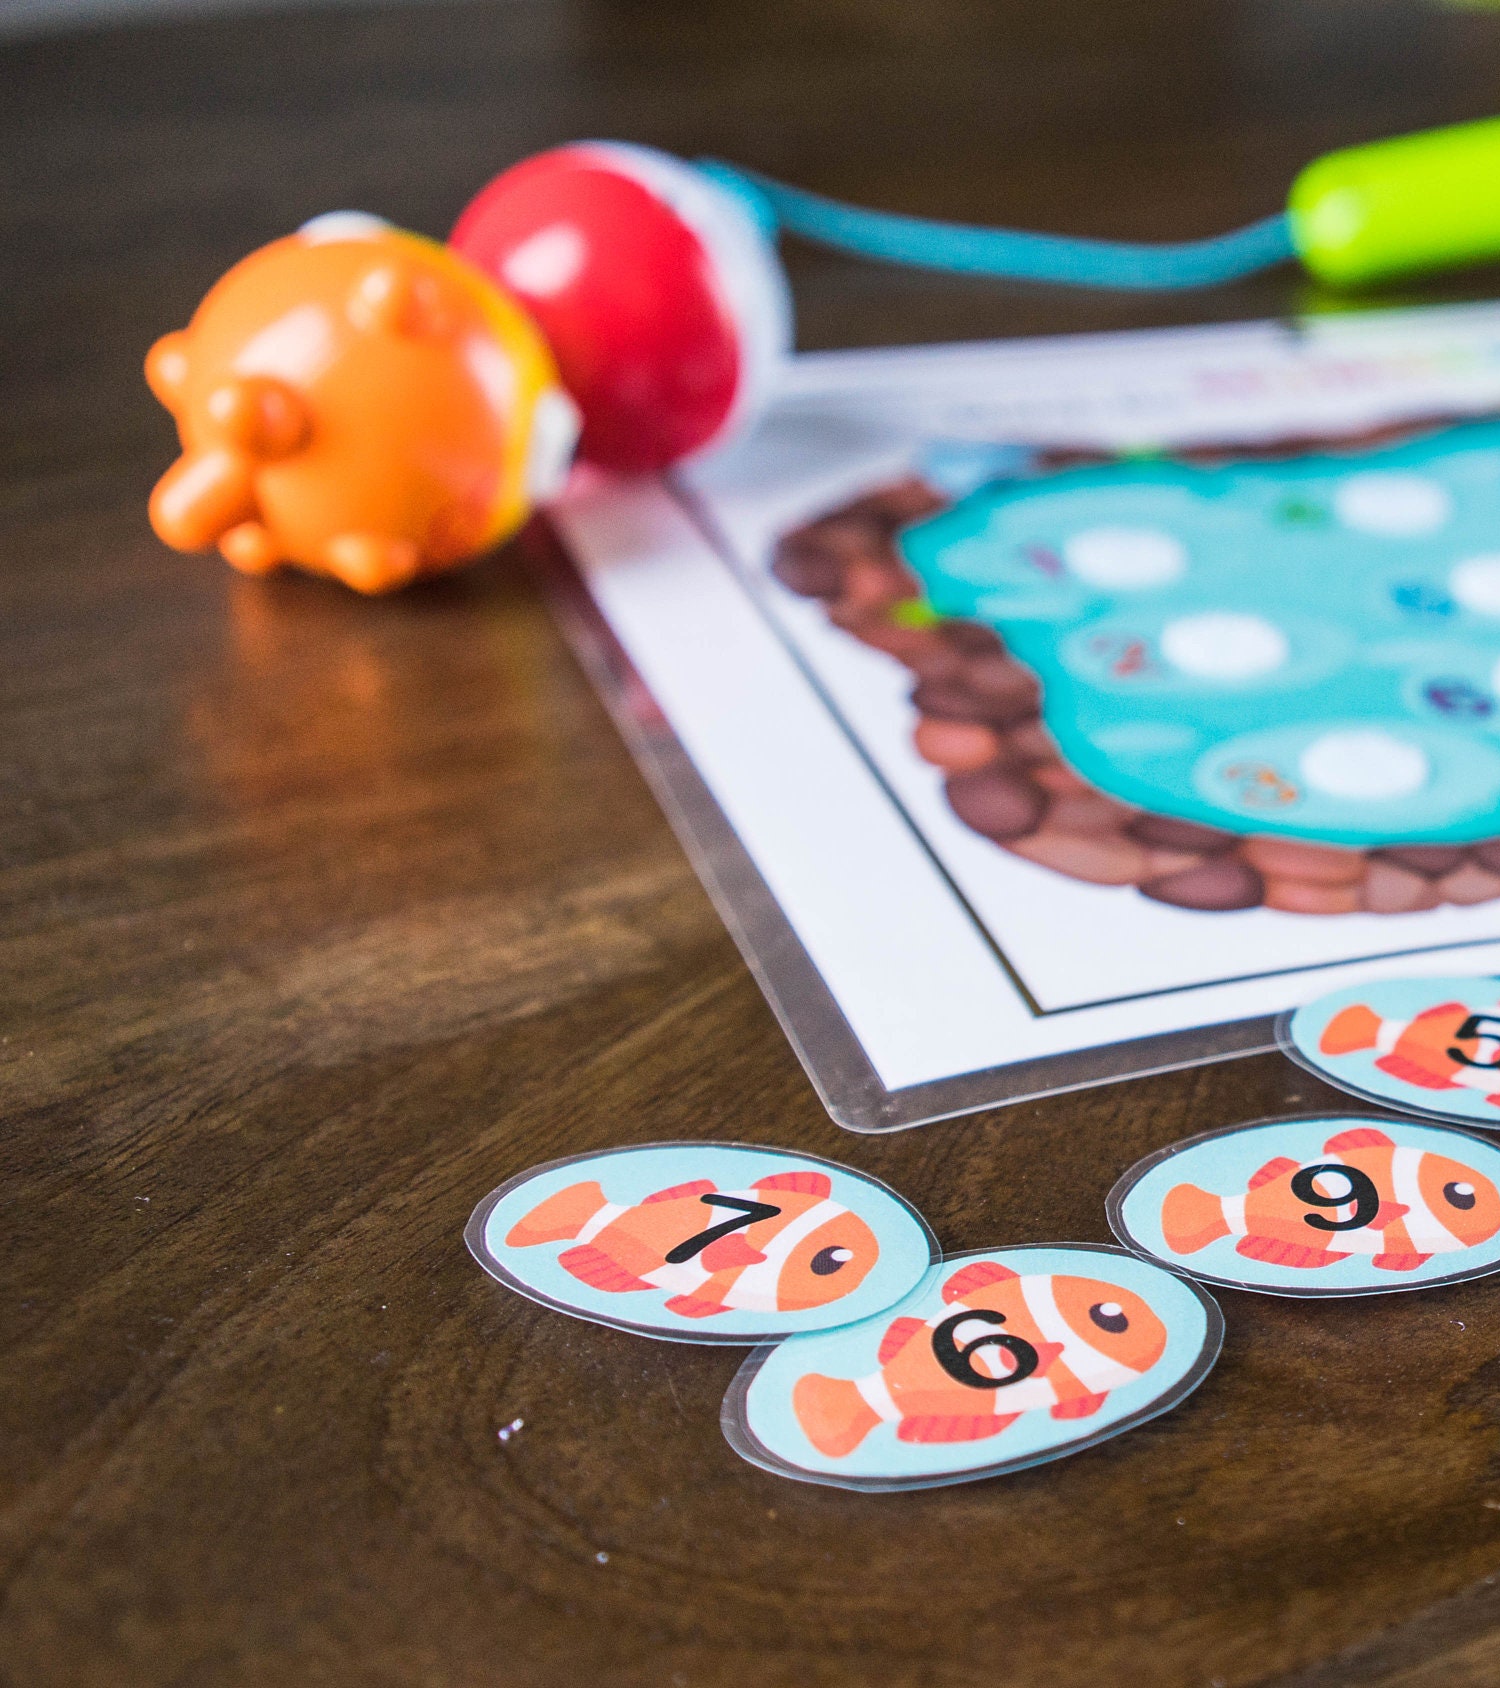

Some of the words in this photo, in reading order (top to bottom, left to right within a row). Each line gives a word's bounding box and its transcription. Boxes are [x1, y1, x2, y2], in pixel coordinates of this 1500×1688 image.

[664, 1192, 783, 1266] 7
[1289, 1162, 1379, 1232] 9
[931, 1308, 1040, 1390] 6
